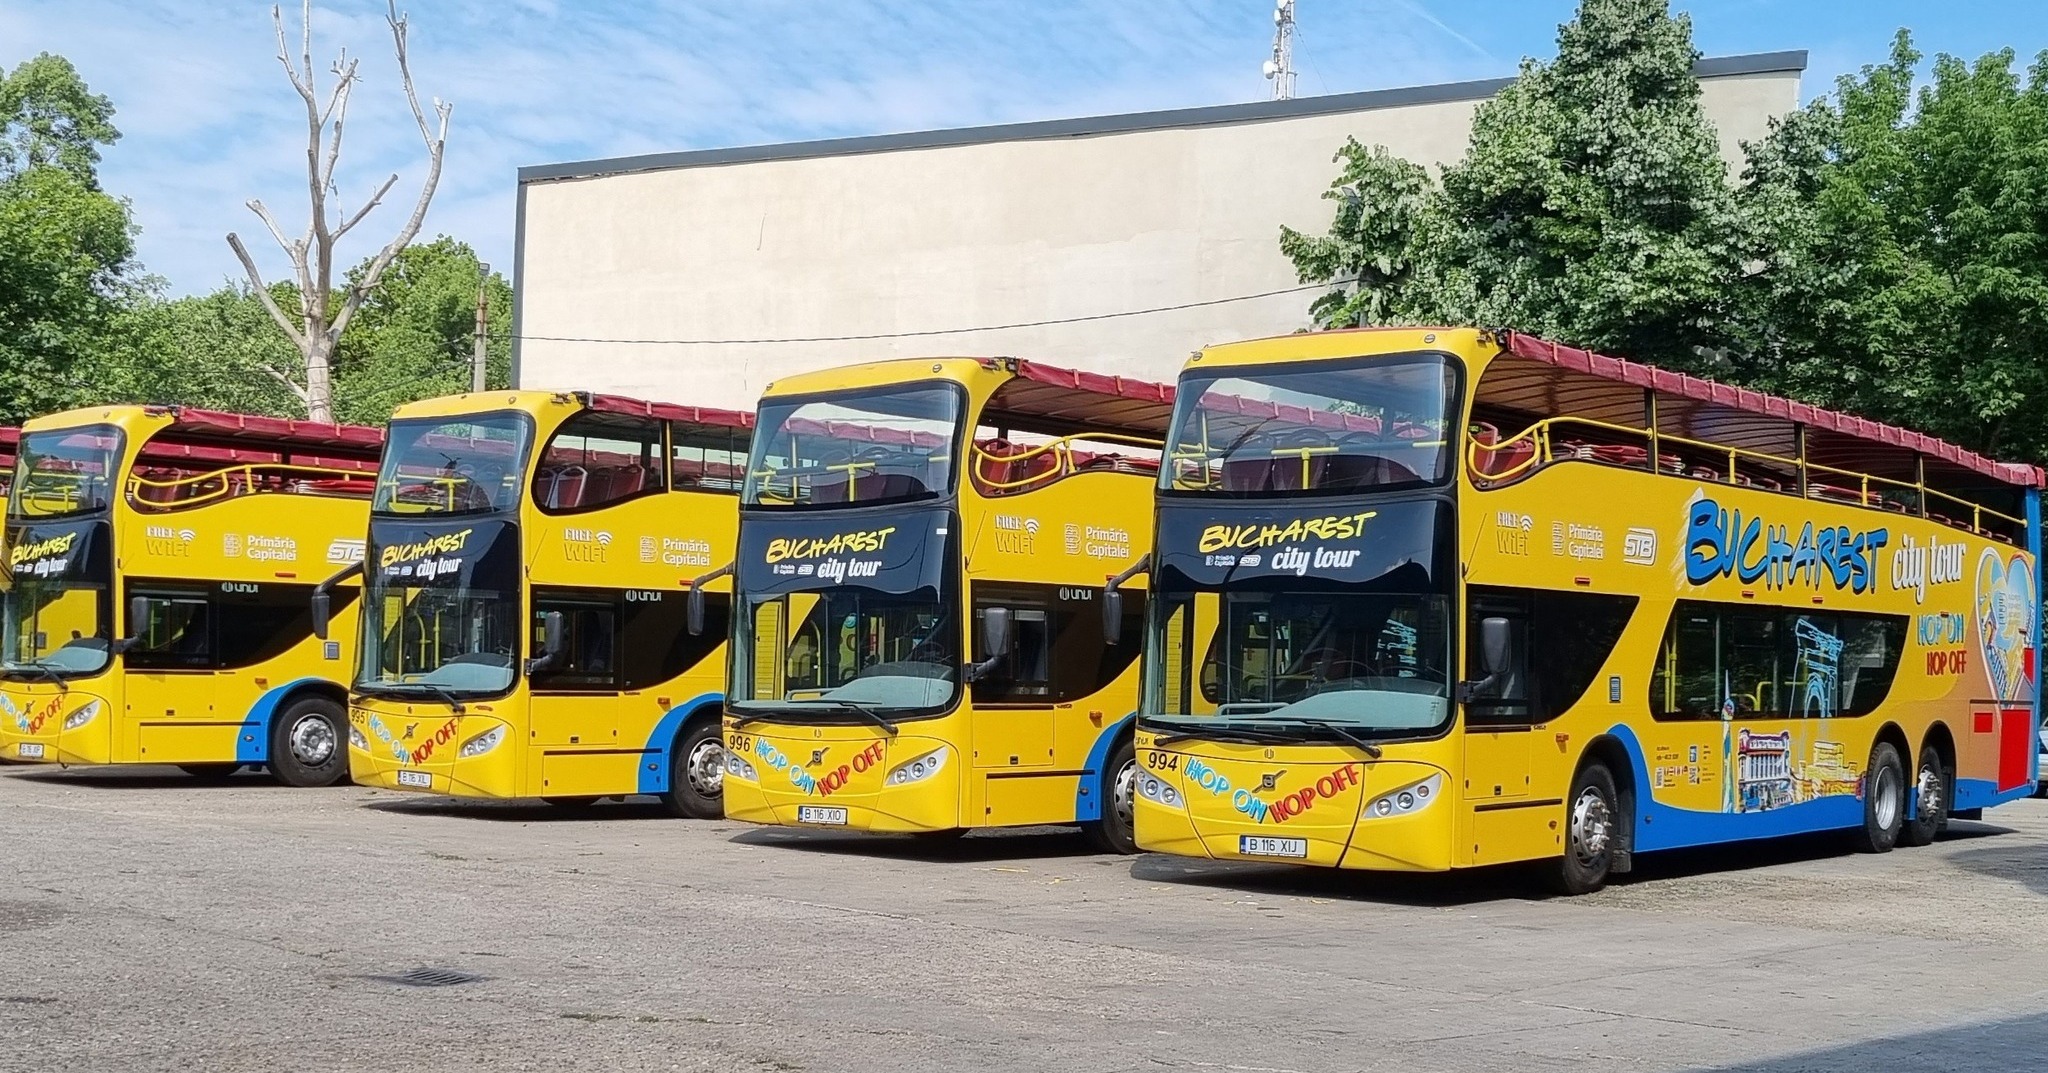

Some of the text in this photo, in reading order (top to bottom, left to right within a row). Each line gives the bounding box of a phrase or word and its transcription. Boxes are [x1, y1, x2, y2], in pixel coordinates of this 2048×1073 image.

[146, 526, 175, 539] FREE
[995, 515, 1021, 530] FREE
[1199, 511, 1377, 554] BUCHAREST
[564, 528, 592, 542] FREE
[766, 527, 896, 564] BUCHAREST
[995, 532, 1034, 555] WiFi
[1497, 530, 1528, 556] WiFi
[1623, 531, 1655, 561] STB
[11, 532, 77, 565] BUCHAREST
[146, 540, 189, 557] WiFi
[247, 548, 297, 562] Capitalei
[381, 528, 472, 567] BUCHAREST
[564, 543, 606, 563] WiFi
[1085, 541, 1129, 560] Capitalei
[1568, 541, 1604, 562] Capitalei
[1685, 498, 1966, 605] BUCHAREST city tour
[416, 558, 437, 580] city
[437, 557, 462, 574] tour
[662, 552, 710, 568] Capitalei
[817, 557, 846, 584] city
[848, 557, 882, 577] tour
[1271, 546, 1360, 577] city tour
[1917, 614, 1942, 646] HOP
[1926, 650, 1967, 676] HOP OFF
[46, 695, 63, 718] OFF
[351, 709, 366, 724] 995
[411, 738, 434, 767] HOP
[435, 718, 457, 746] OFF
[729, 735, 751, 752] 996
[755, 736, 884, 797] HOP ON HOP OFF
[1148, 752, 1178, 772] 994
[1184, 756, 1360, 824] HOP ON HOP OFF
[805, 809, 841, 821] B 116 XIO
[1250, 838, 1297, 853] B 116 XIJ
